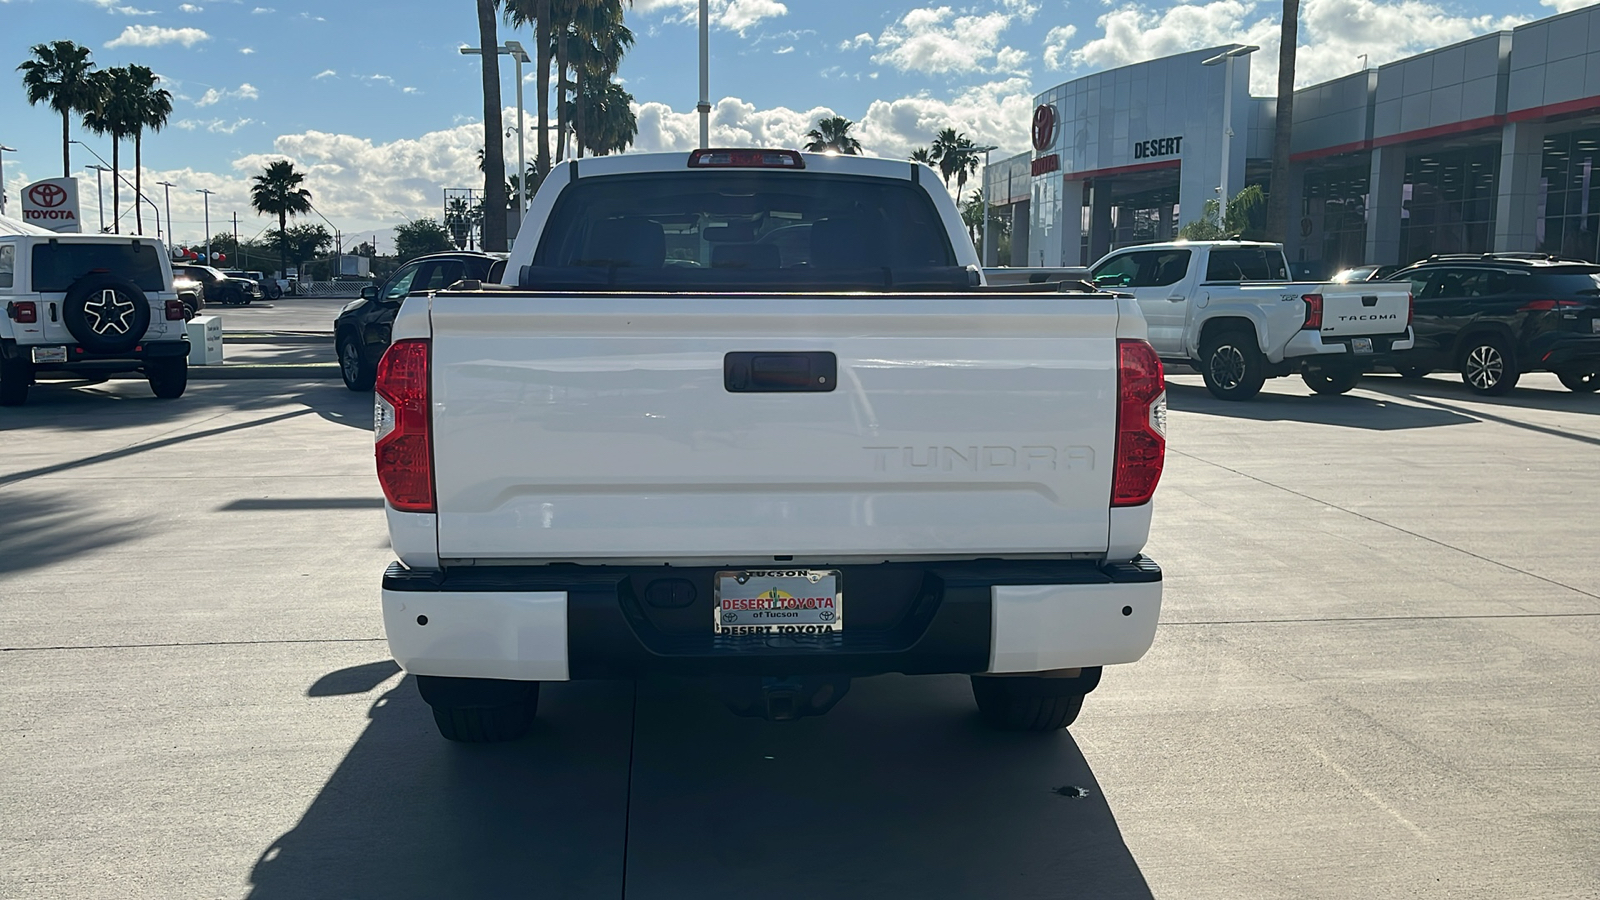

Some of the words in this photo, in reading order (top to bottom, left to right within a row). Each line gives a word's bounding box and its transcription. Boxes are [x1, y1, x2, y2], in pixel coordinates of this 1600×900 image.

[1134, 136, 1183, 159] DESERT
[23, 210, 75, 220] TOYOTA
[862, 445, 1095, 472] TUNDRA
[722, 599, 773, 610] DESERT
[780, 597, 834, 609] TOYOTA
[721, 626, 772, 635] DESERT
[777, 625, 833, 634] TOYOTA
